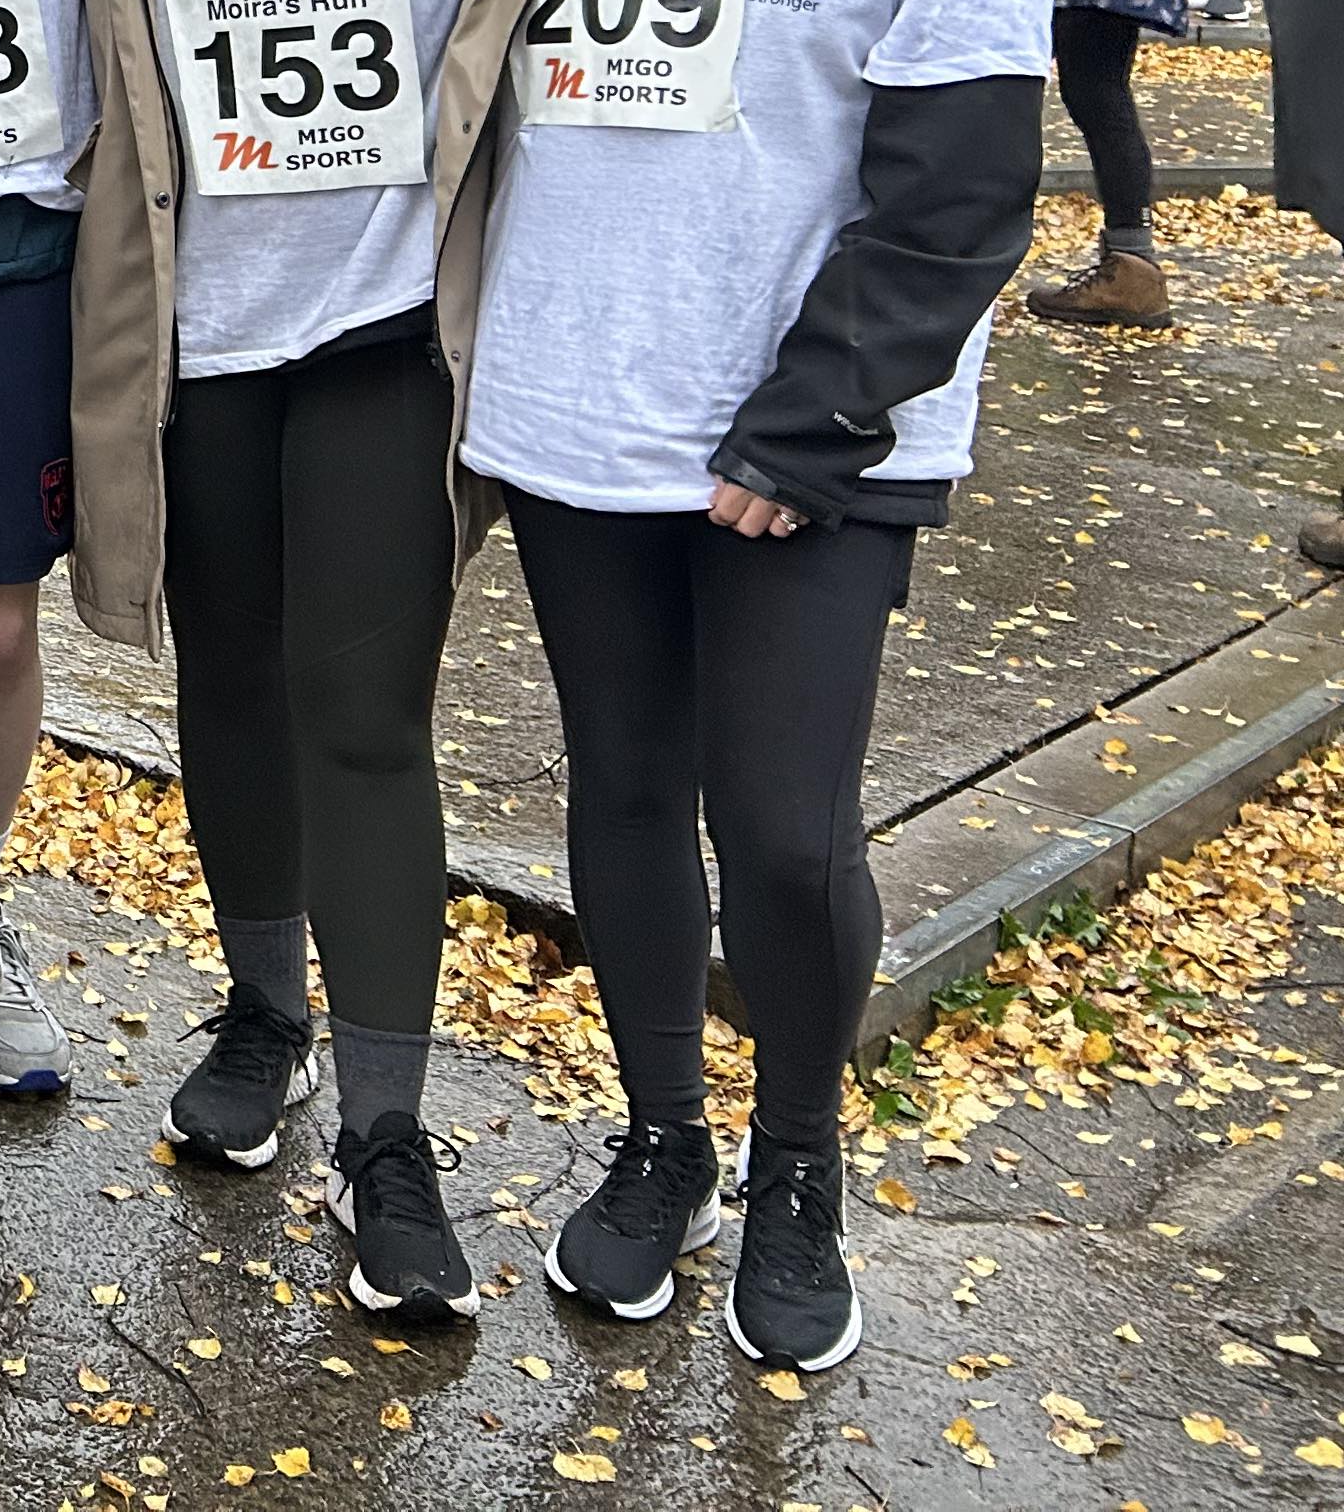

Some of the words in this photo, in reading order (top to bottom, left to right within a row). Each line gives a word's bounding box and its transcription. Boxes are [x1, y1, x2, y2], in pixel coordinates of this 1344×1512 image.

[194, 19, 400, 119] 153
[607, 59, 673, 78] MIGO
[594, 85, 687, 106] SPORTS
[298, 125, 365, 145] MIGO
[286, 148, 382, 171] SPORTS
